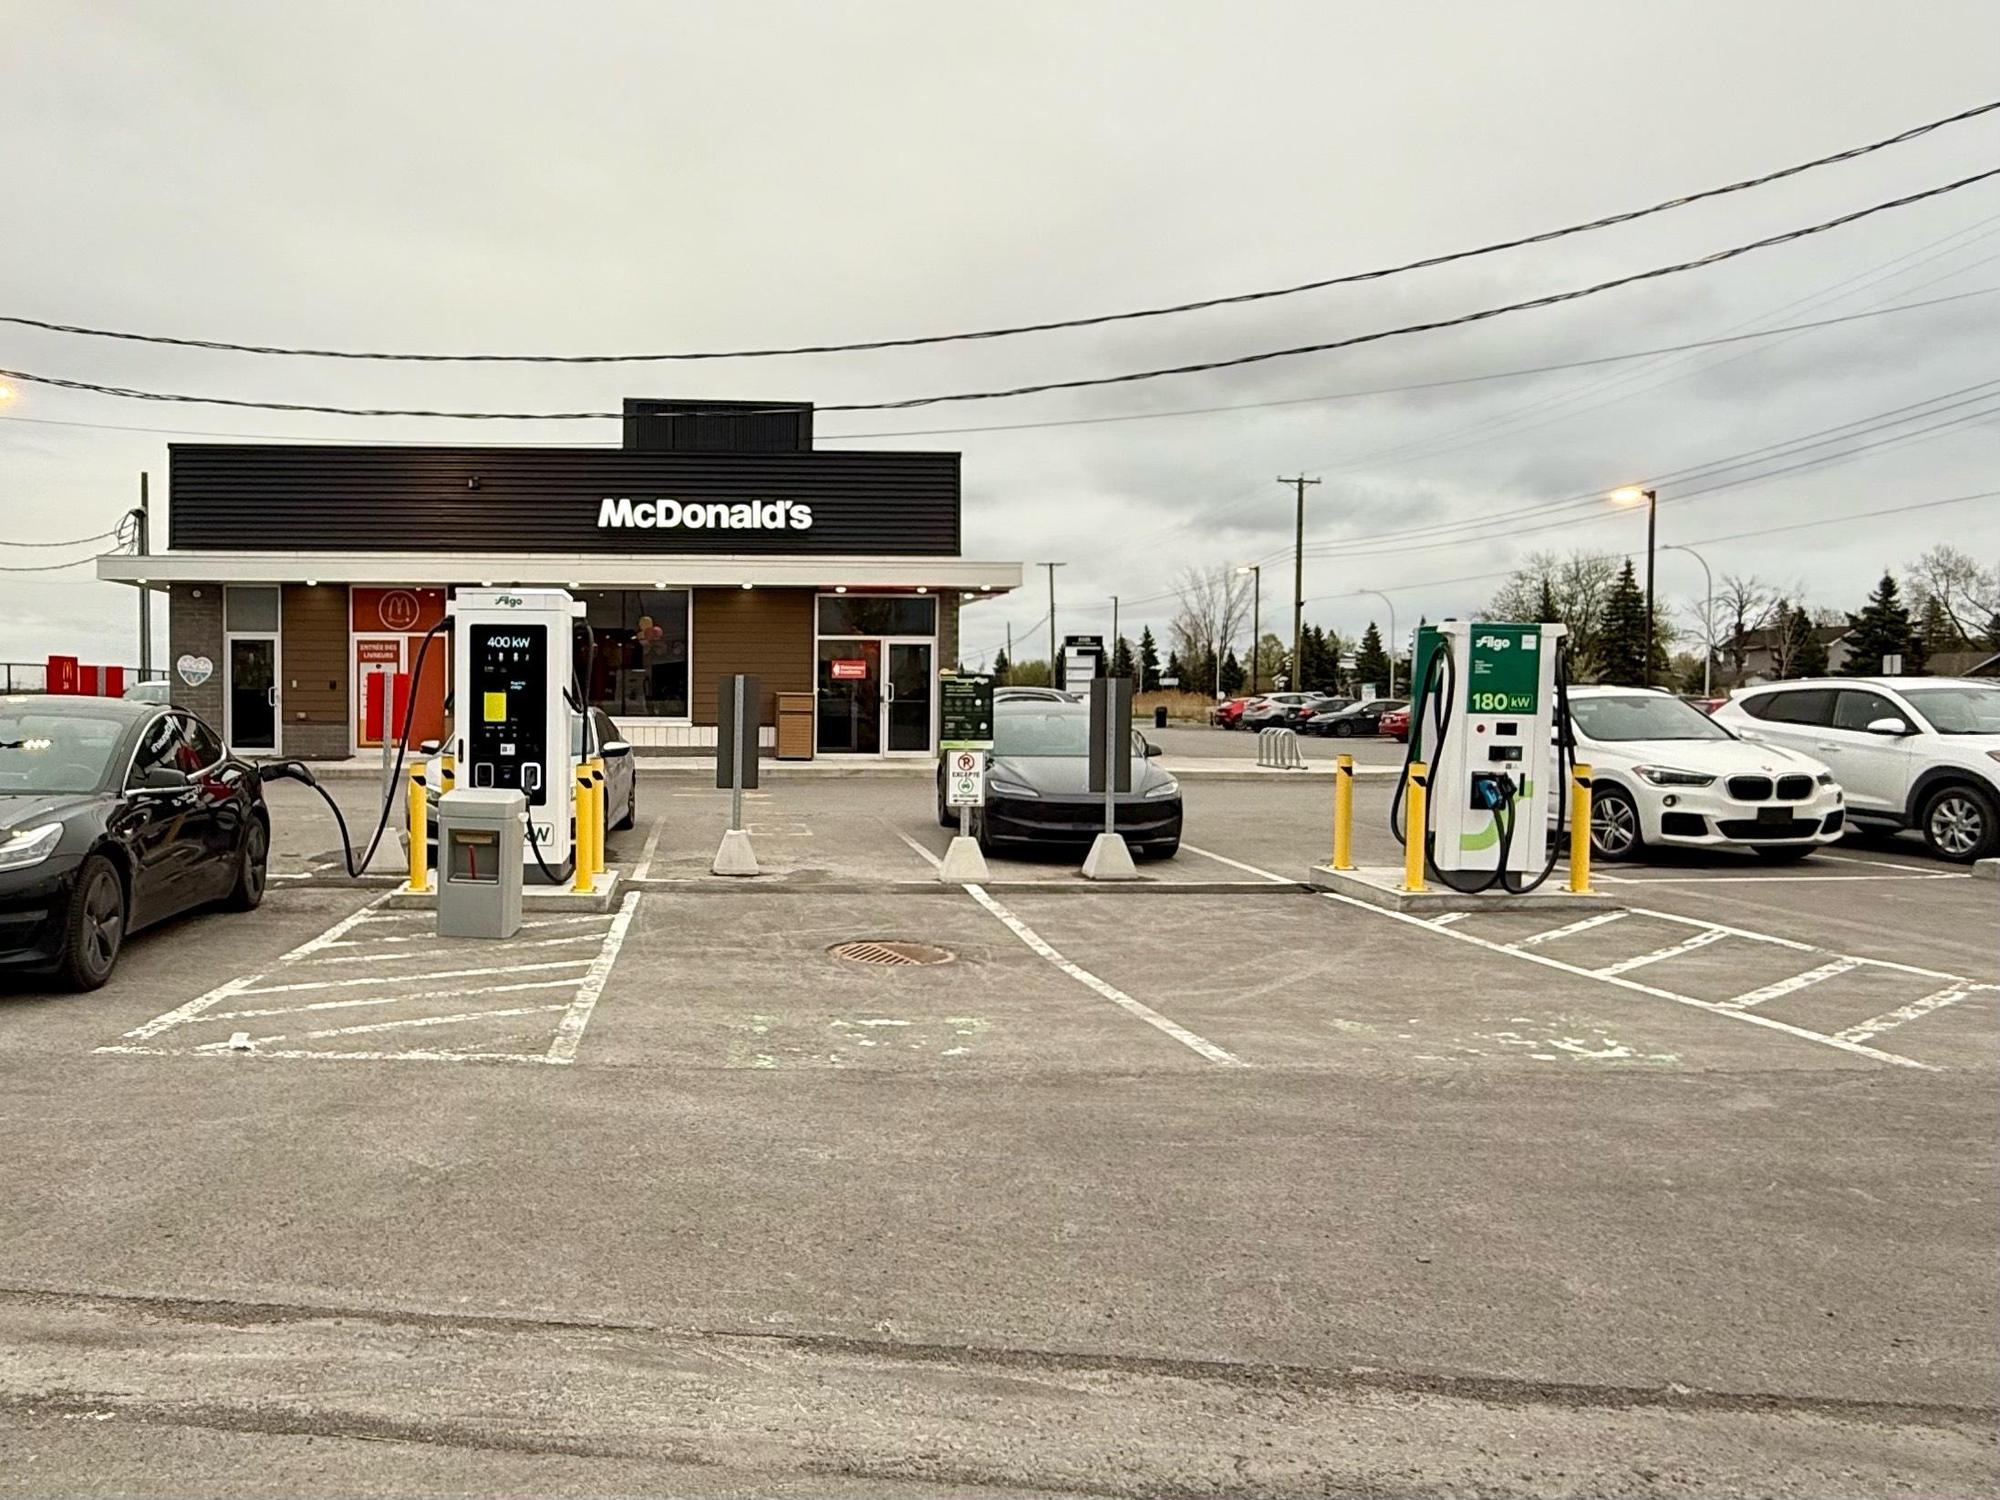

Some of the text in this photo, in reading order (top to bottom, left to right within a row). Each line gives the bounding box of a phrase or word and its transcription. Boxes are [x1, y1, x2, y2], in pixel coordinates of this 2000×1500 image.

[598, 498, 813, 529] McDonald's
[487, 636, 531, 648] 400 kW
[1475, 635, 1511, 651] Filgo
[1472, 693, 1530, 711] 180 kW
